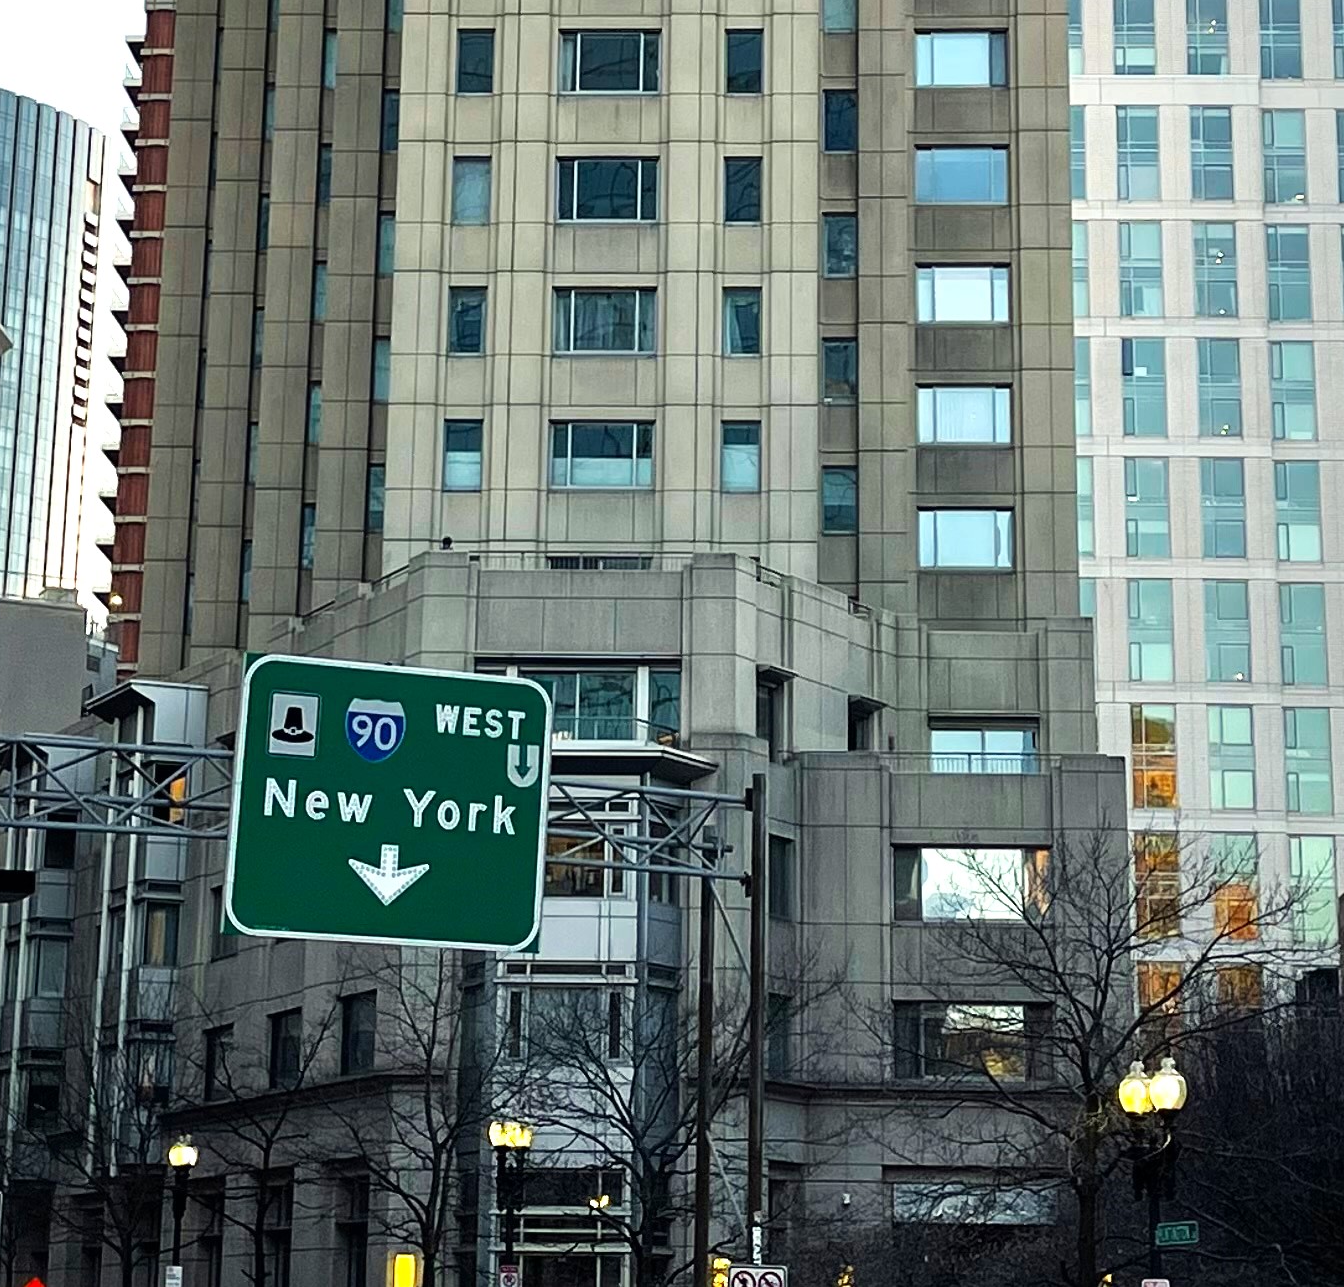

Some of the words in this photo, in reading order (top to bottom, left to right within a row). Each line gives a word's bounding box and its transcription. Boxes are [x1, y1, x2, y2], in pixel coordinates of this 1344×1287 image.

[351, 714, 398, 752] 90
[435, 703, 527, 740] WEST
[263, 777, 374, 824] New
[403, 788, 518, 836] York
